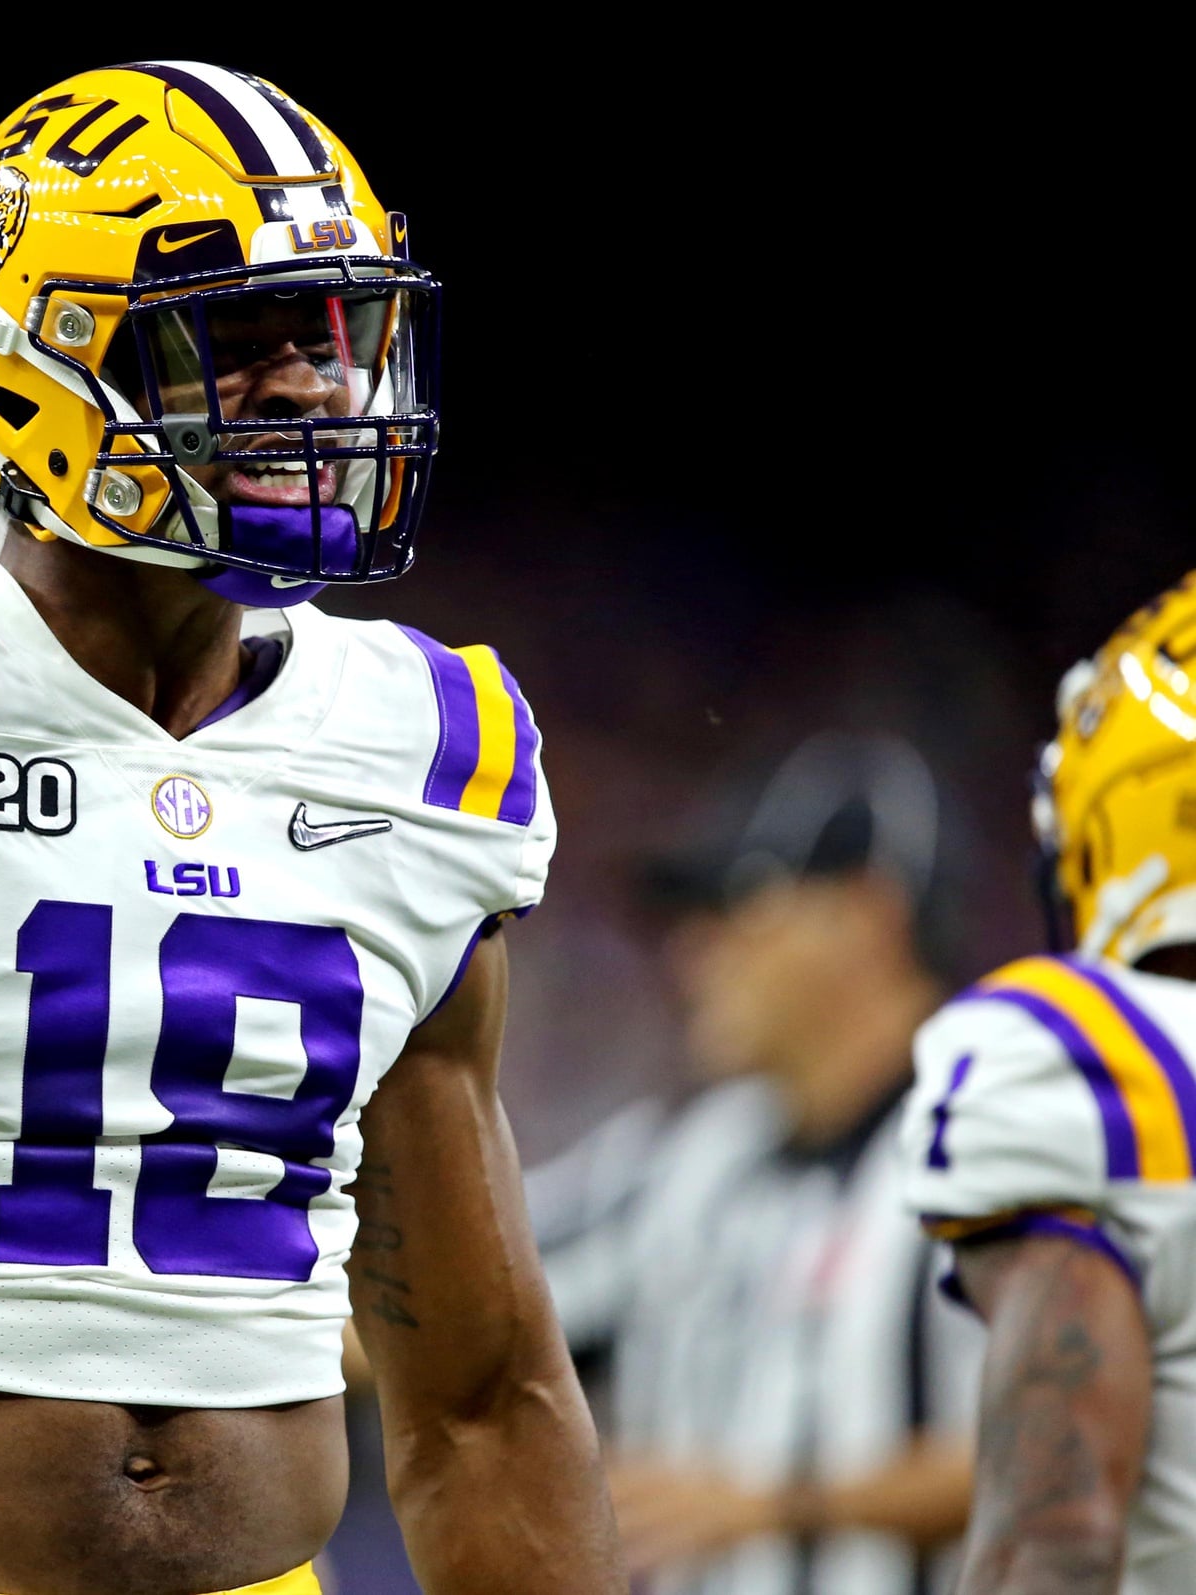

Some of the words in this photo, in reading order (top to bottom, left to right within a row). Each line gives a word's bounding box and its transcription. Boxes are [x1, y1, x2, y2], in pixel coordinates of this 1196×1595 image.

[287, 219, 357, 254] LSU
[154, 777, 210, 836] SEC
[144, 860, 241, 898] LSU
